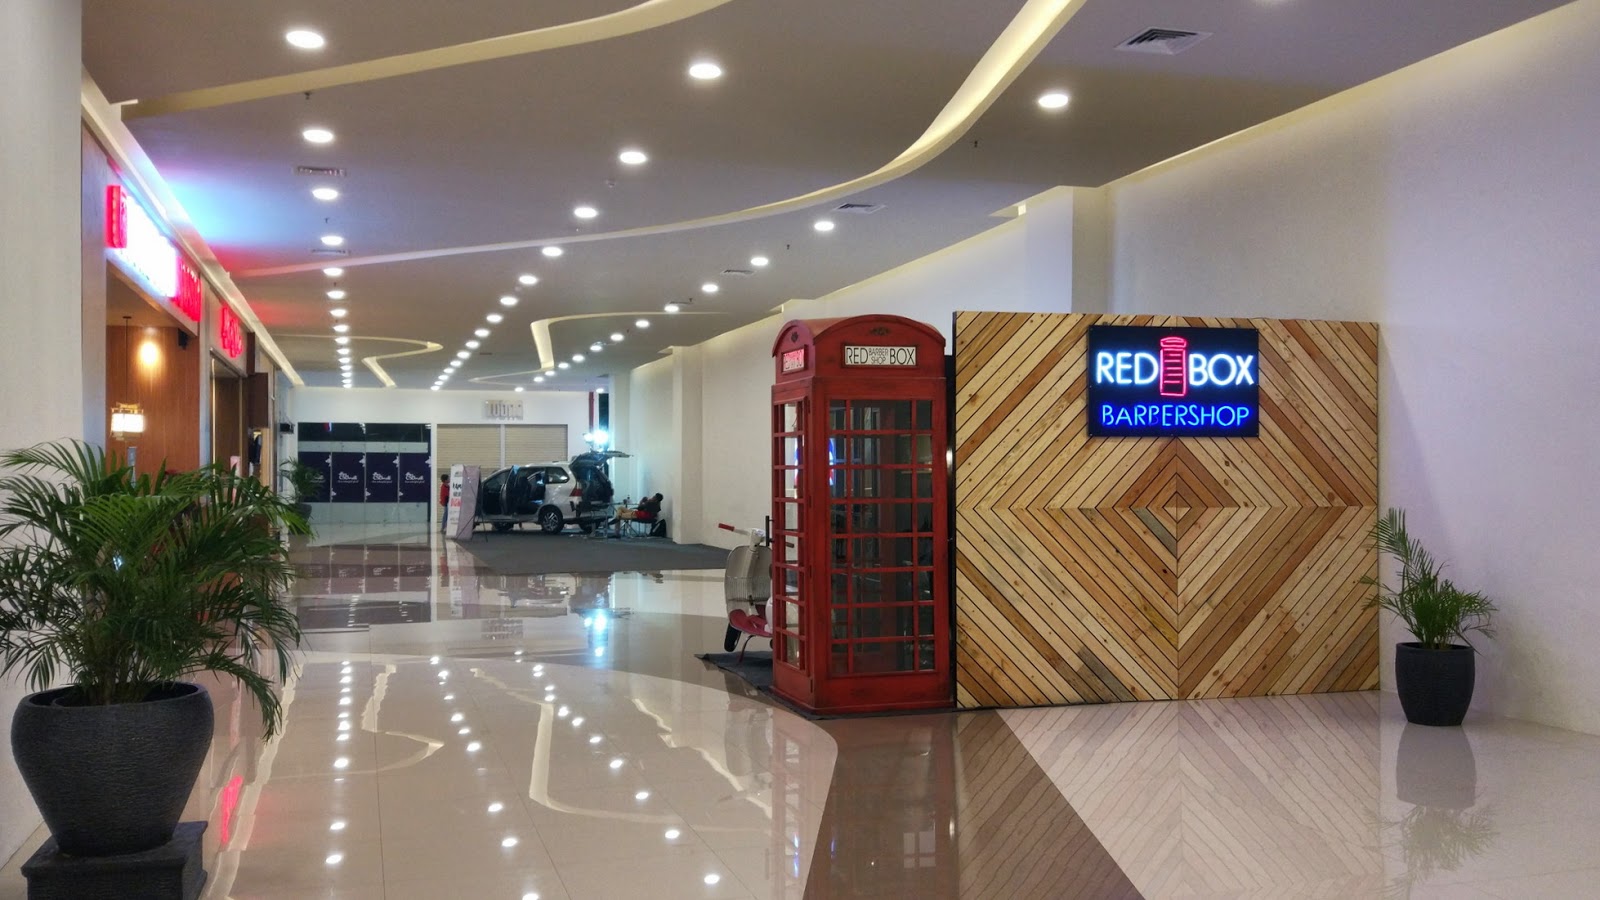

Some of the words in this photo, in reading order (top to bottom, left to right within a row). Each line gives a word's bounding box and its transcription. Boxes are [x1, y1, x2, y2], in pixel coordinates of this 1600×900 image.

[846, 347, 868, 364] RED
[889, 348, 915, 365] BOX
[869, 347, 889, 356] BARBER
[871, 356, 886, 364] SHOP
[1096, 351, 1159, 384] RED
[1188, 353, 1254, 386] BOX
